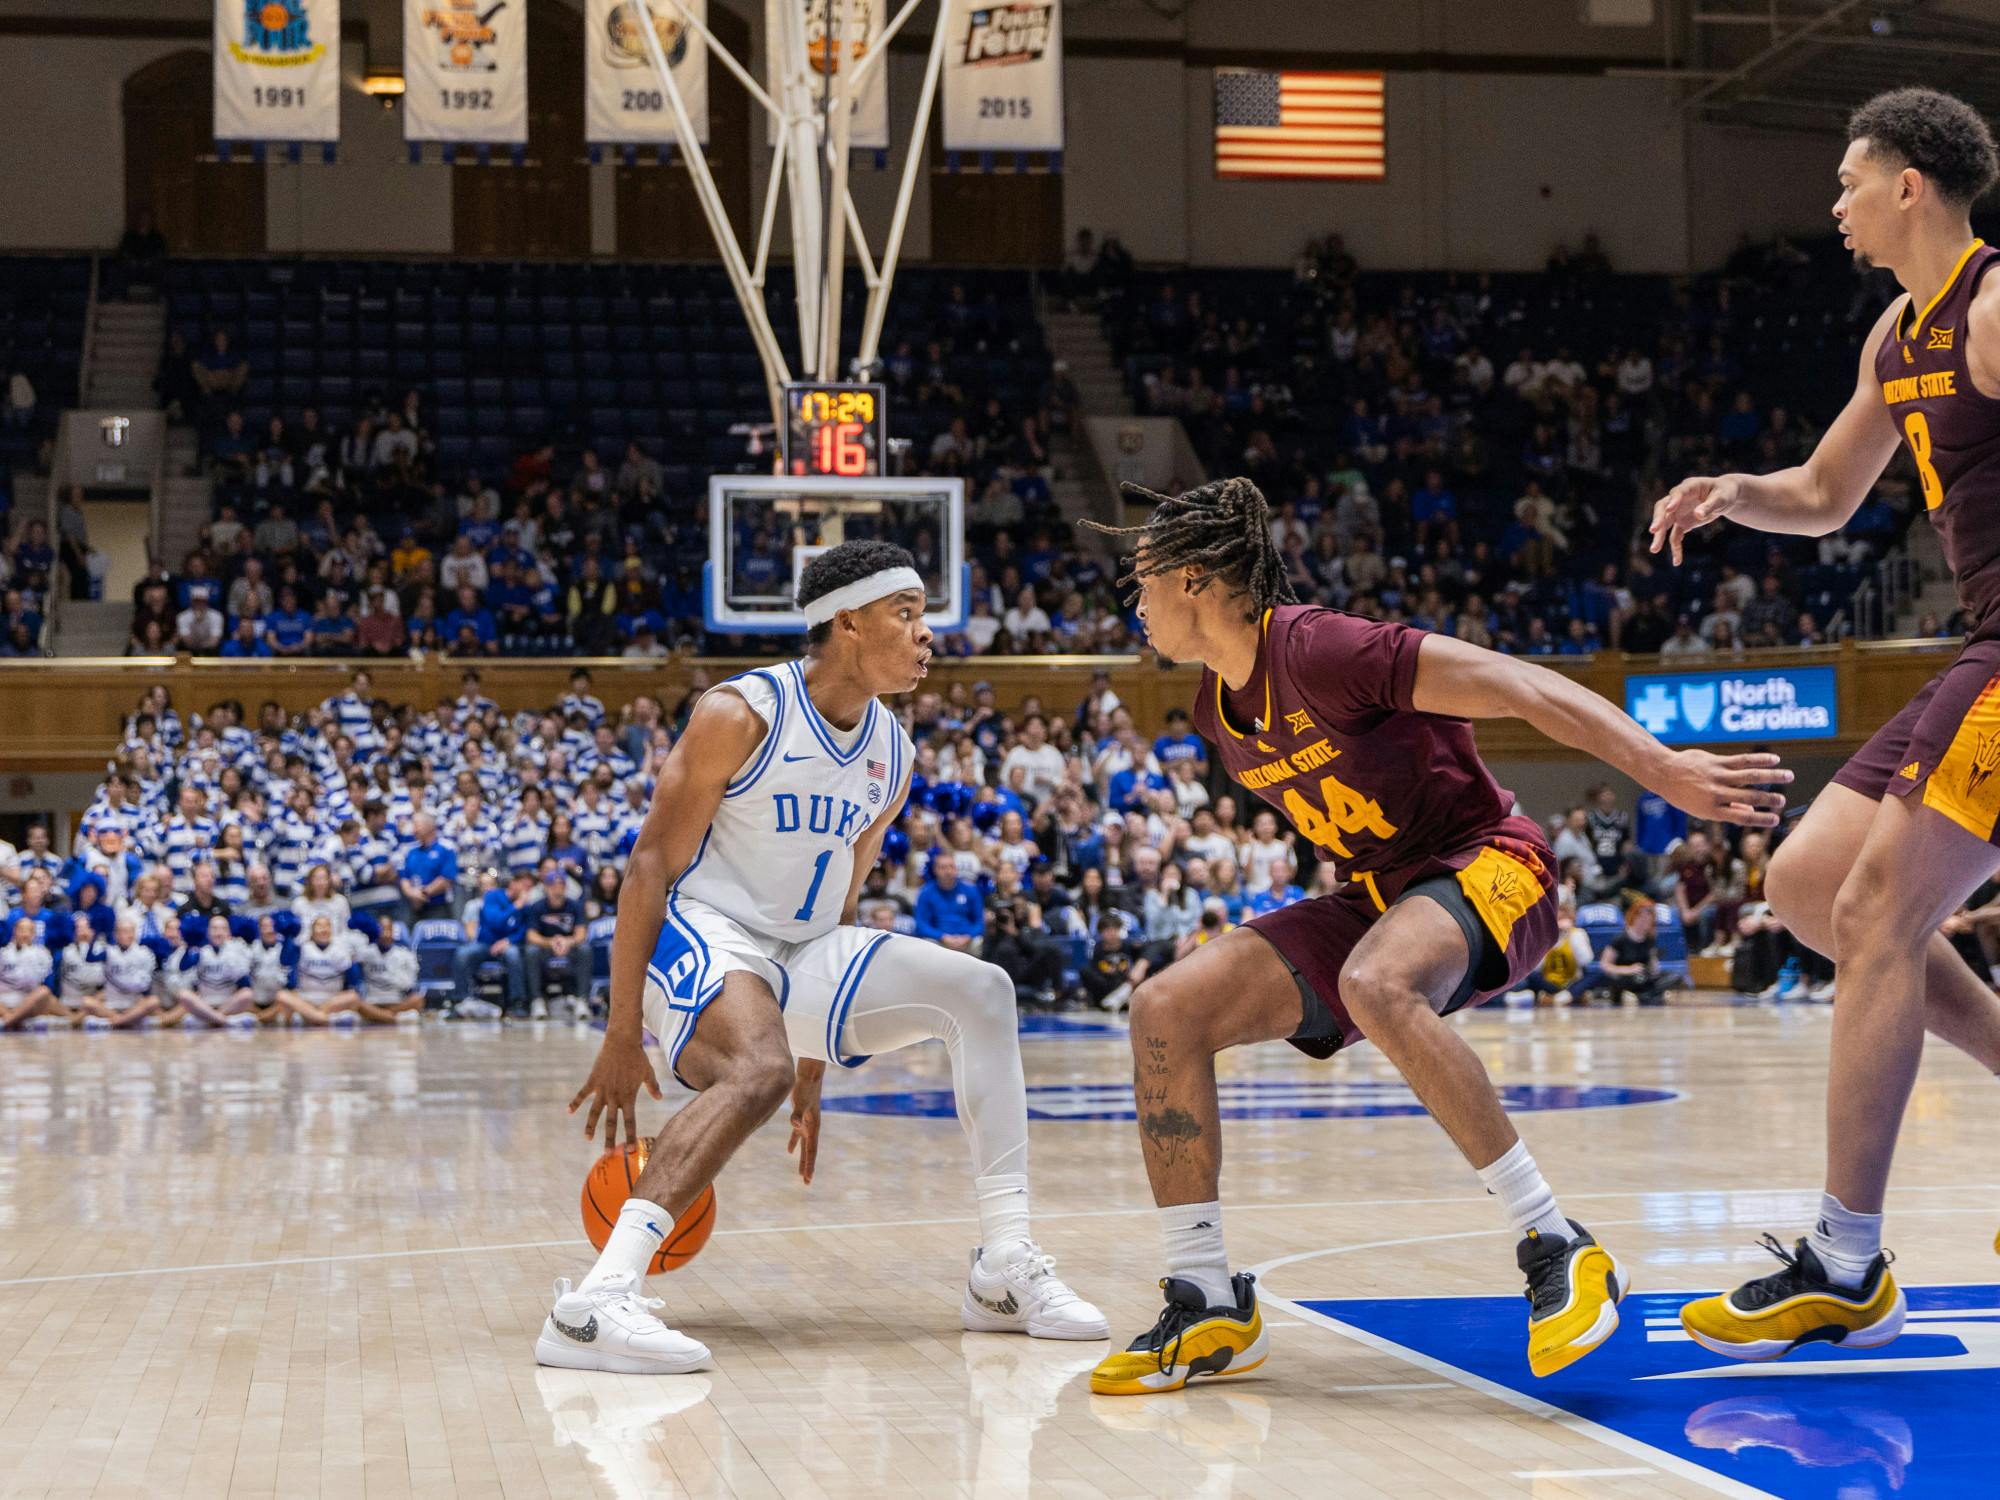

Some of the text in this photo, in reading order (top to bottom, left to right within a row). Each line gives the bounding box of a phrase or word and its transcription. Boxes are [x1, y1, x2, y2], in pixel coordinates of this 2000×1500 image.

[253, 87, 305, 108] 1991
[441, 88, 493, 110] 1992
[622, 88, 664, 112] 200
[979, 96, 1032, 119] 2015
[1920, 371, 1957, 398] STATE
[801, 391, 875, 424] 17:29
[818, 422, 867, 477] 16
[1904, 411, 1944, 511] 8
[1720, 677, 1796, 706] North
[1720, 702, 1830, 733] Carolina
[1238, 737, 1342, 789] ARIZONA STATE
[1283, 774, 1399, 859] 44
[794, 850, 834, 921] 1
[1146, 1036, 1168, 1048] Me
[1151, 1051, 1166, 1062] Vs
[1143, 1086, 1168, 1105] 44
